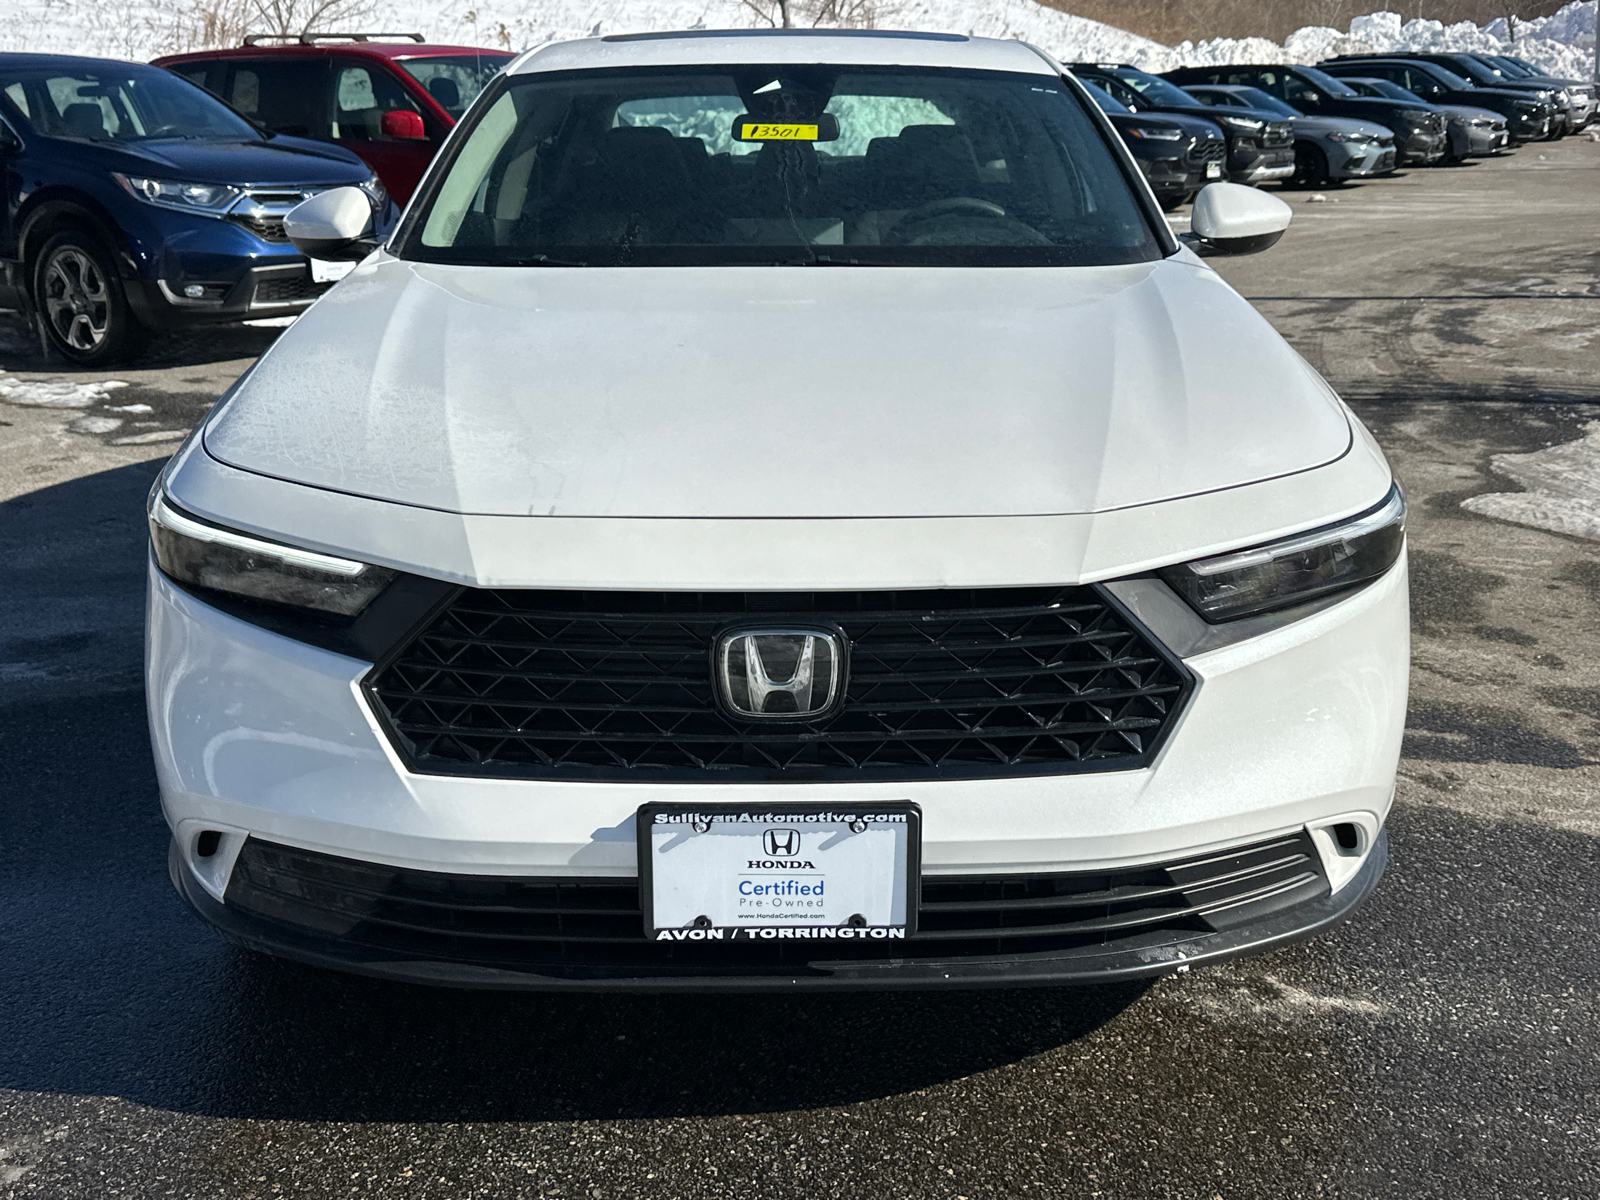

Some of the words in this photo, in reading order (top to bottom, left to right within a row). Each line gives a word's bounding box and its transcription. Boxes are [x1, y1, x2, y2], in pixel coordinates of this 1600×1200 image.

[654, 812, 907, 824] SullivanAutomotive.com
[747, 860, 816, 869] HONDA
[738, 880, 824, 896] Certified
[739, 898, 824, 907] Pre-Owned
[656, 928, 724, 941] AVON
[744, 928, 906, 939] TORRINGTON
